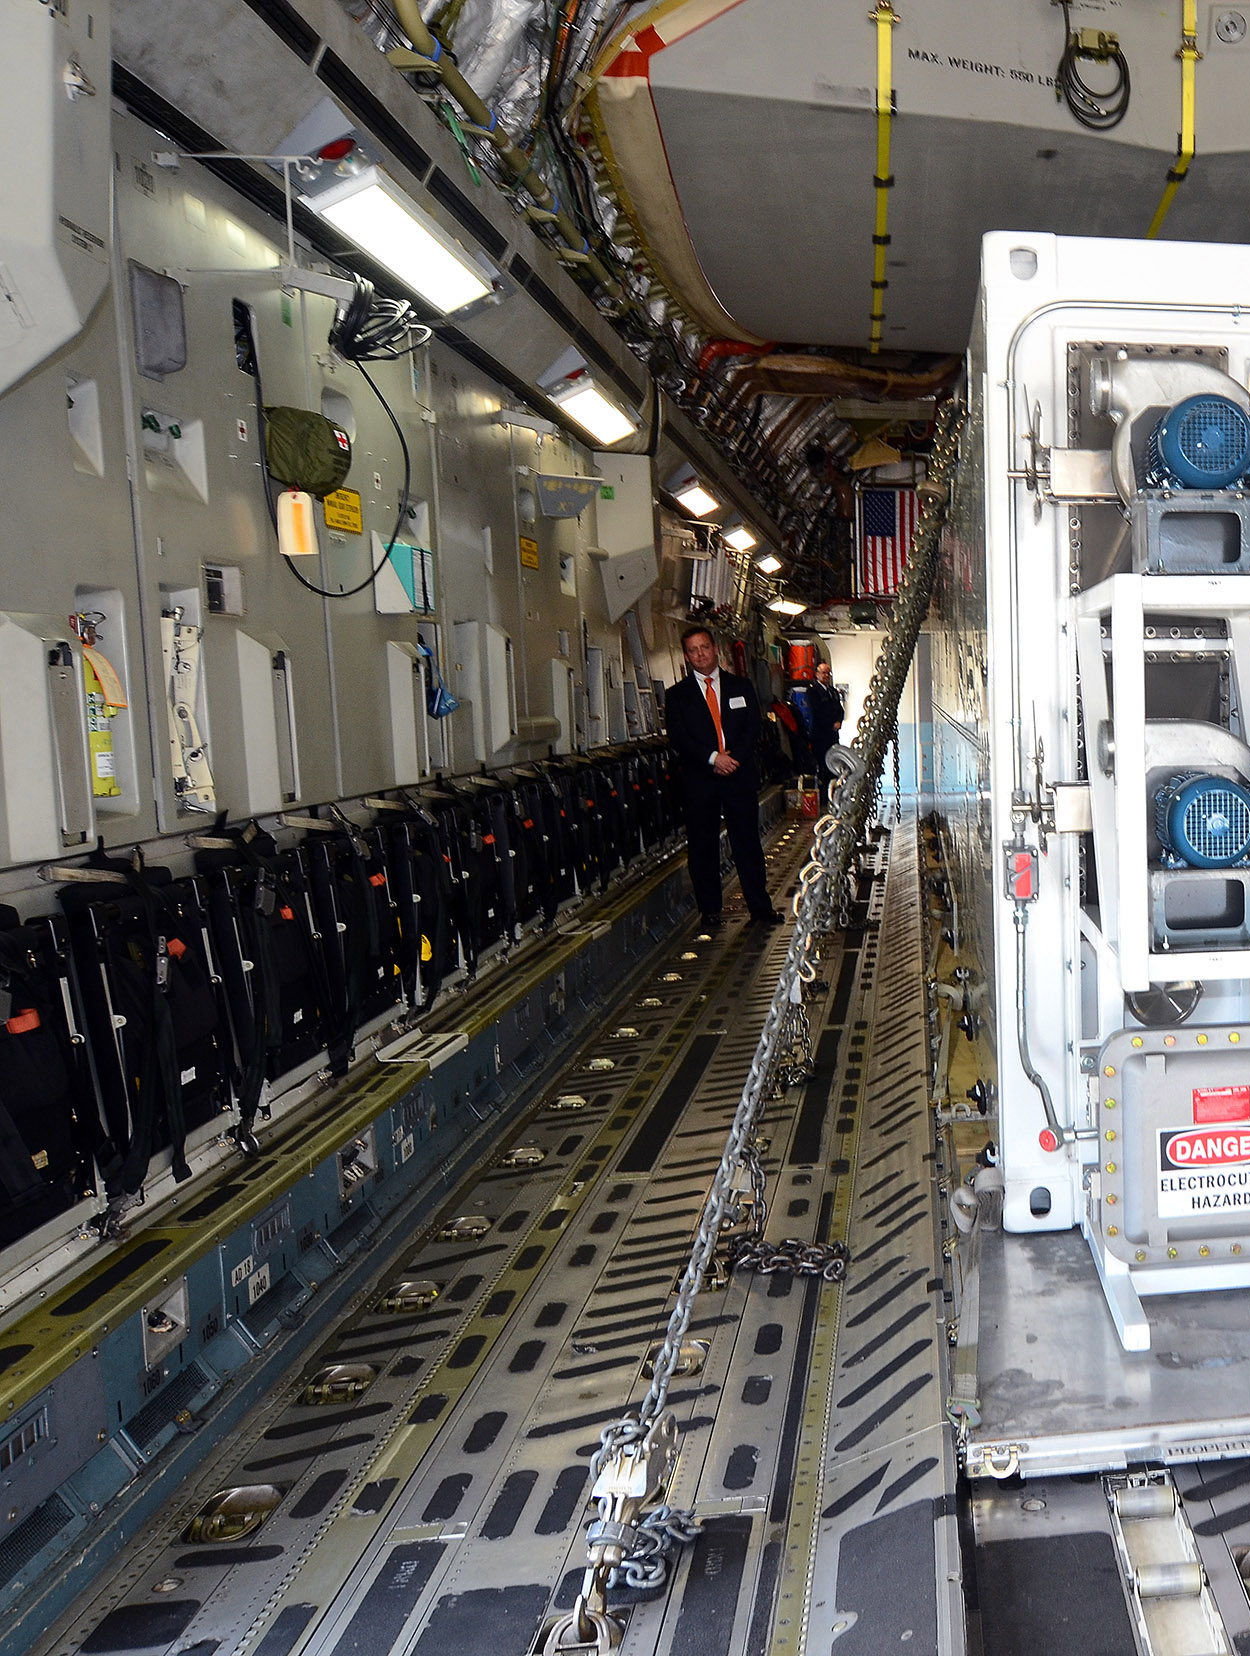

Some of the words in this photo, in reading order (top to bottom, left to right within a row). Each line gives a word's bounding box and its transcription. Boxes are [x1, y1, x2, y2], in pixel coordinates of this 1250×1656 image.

[908, 48, 943, 65] MAX.
[948, 55, 1005, 78] WEIGHT:
[1009, 68, 1034, 83] 550
[1037, 74, 1061, 89] LBS
[234, 1267, 242, 1284] AD
[252, 1275, 267, 1300] 1040
